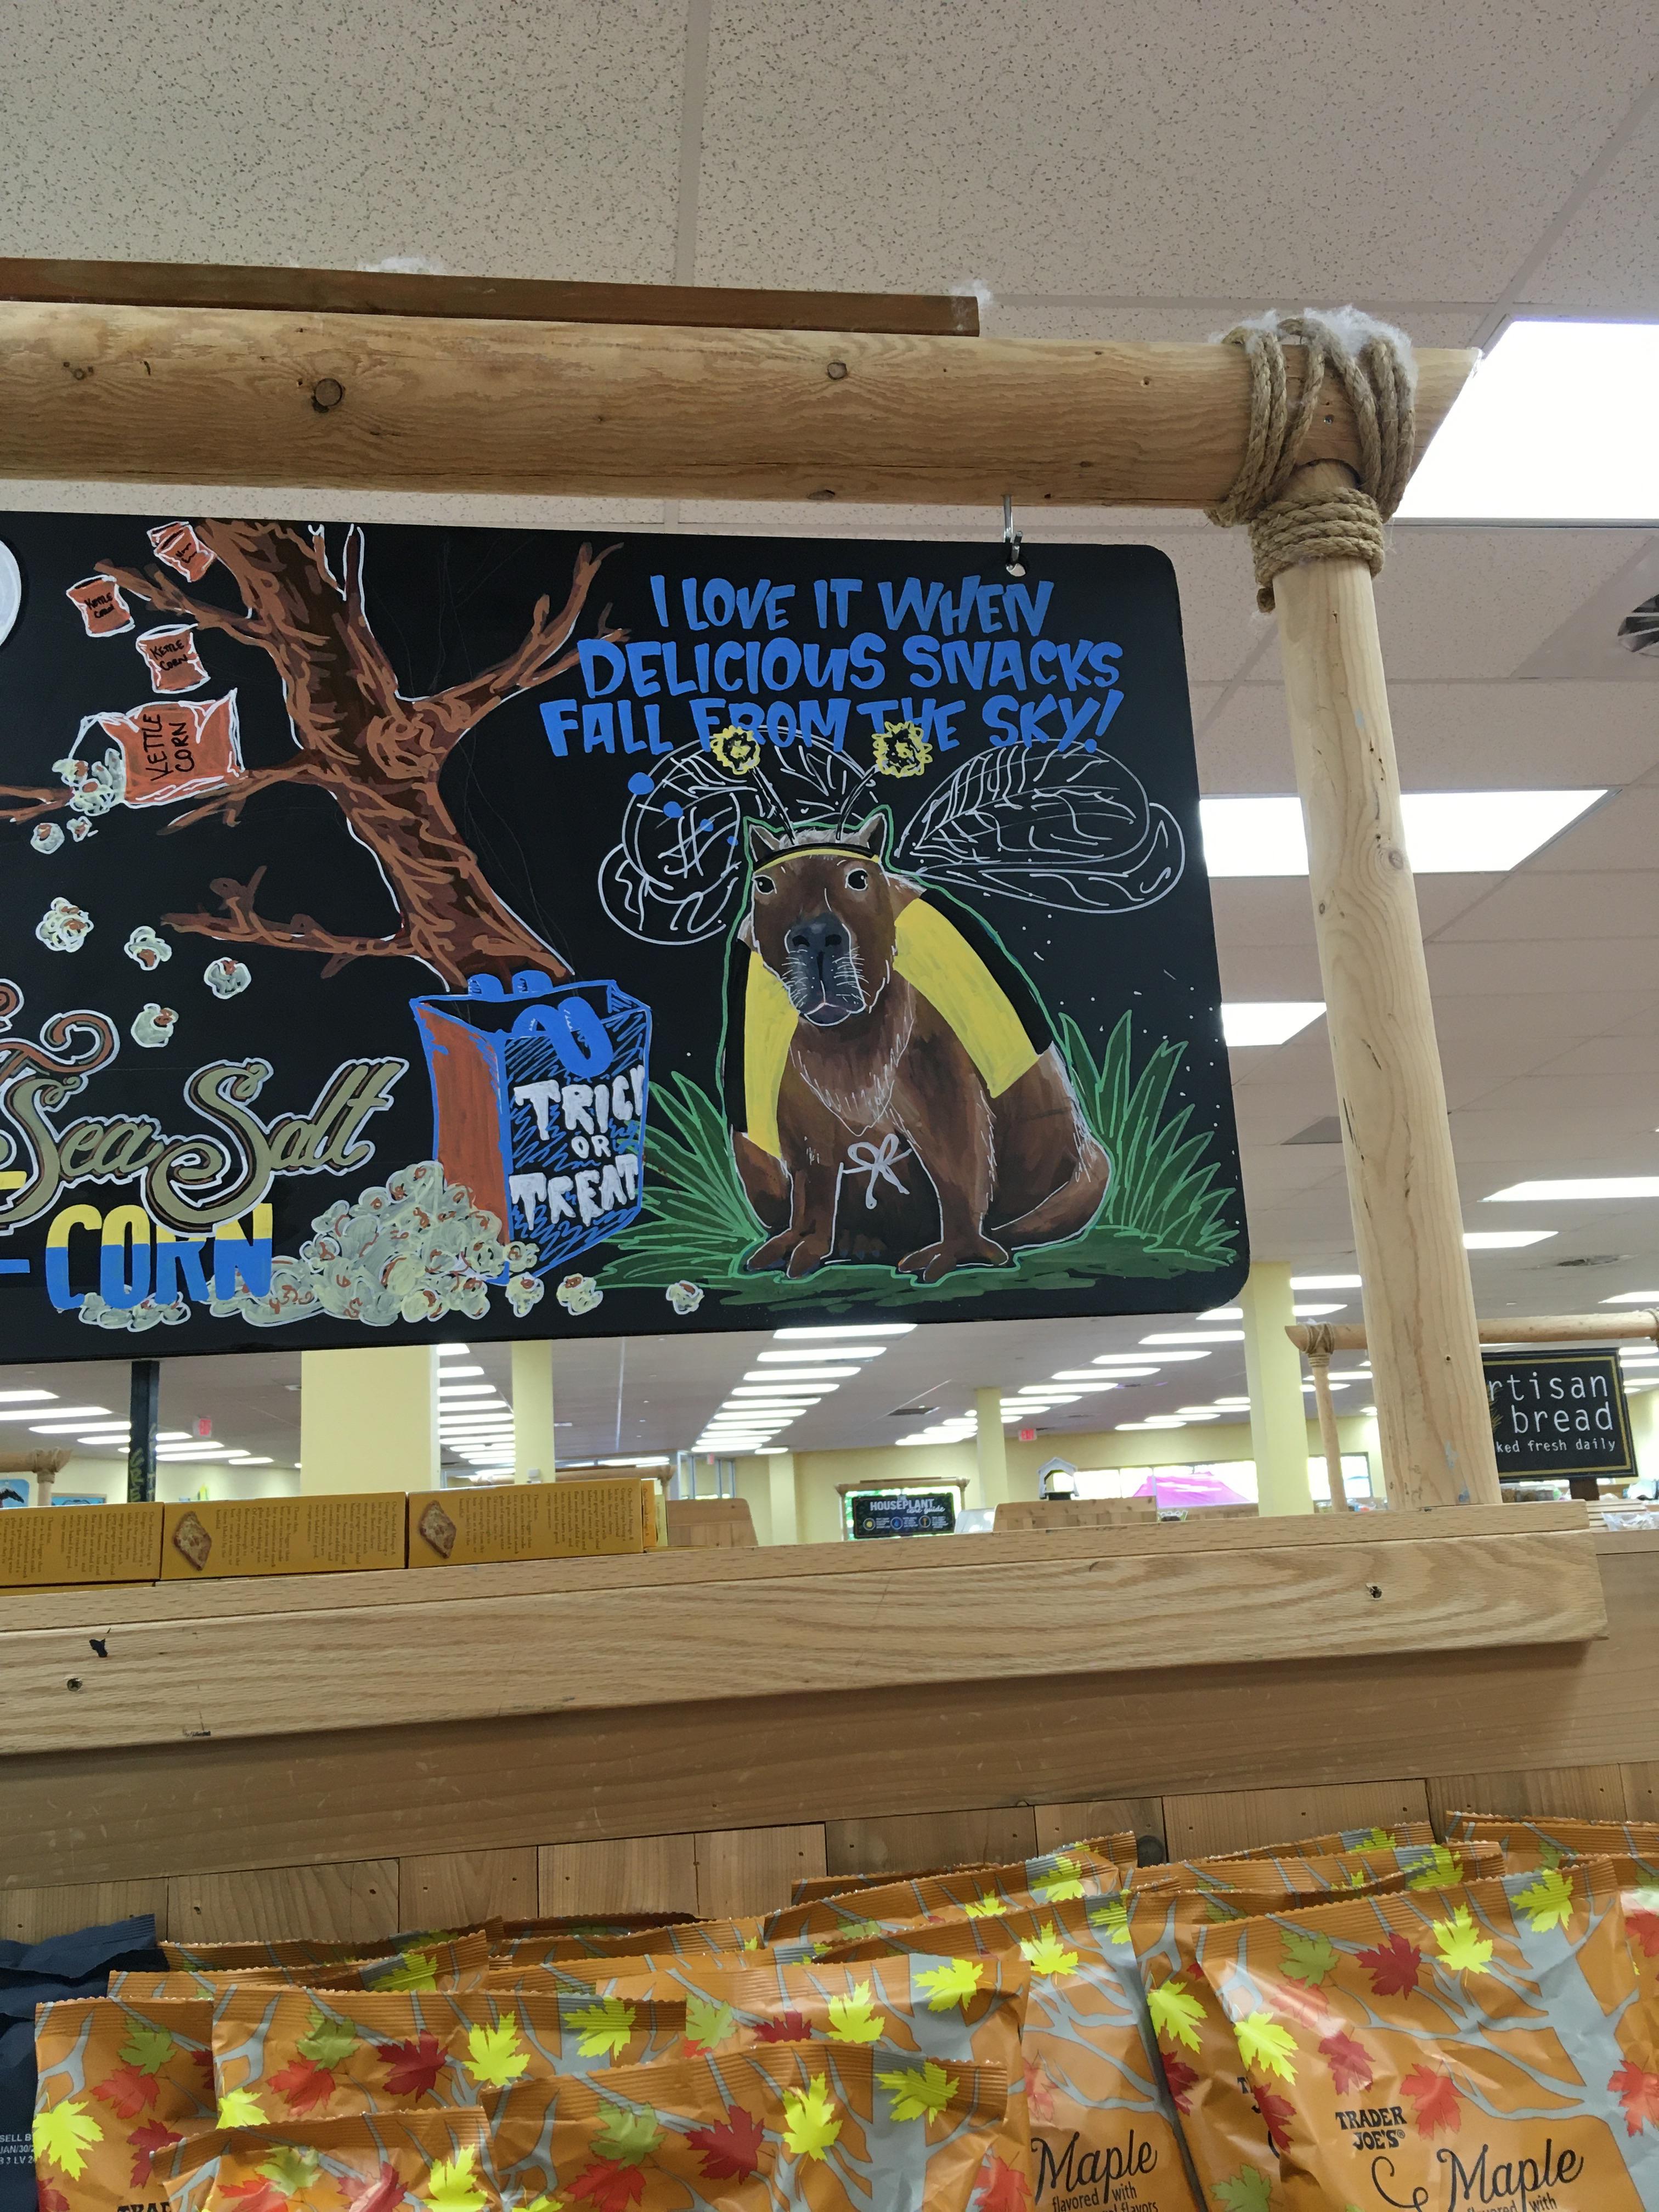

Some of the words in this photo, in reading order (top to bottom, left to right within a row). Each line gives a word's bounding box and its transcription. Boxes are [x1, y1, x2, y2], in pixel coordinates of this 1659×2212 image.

[651, 575, 669, 627] I
[682, 577, 795, 631] LOVE
[814, 579, 863, 629] IT
[878, 575, 1054, 636] WHEN
[150, 639, 184, 659] KETTLE
[159, 653, 188, 671] CORN
[577, 632, 886, 698] DELICIOUS
[902, 635, 1123, 691] SNACKS
[539, 699, 673, 757] FALL
[689, 698, 851, 753] FROM
[856, 697, 966, 752] THE
[982, 689, 1125, 754] SKY!
[142, 714, 174, 781] KETTLE
[168, 722, 195, 772] CORN
[0, 1075, 166, 1232] Sea
[145, 1059, 406, 1237] Salt
[571, 1135, 612, 1159] OR
[509, 1154, 640, 1231] TREAT
[1488, 1372, 1608, 1401] rtisan
[1511, 1401, 1613, 1434] bread
[1496, 1440, 1520, 1453] ked
[1527, 1439, 1567, 1452] fresh
[1576, 1437, 1616, 1452] daily
[870, 1499, 934, 1511] HOUSEPLANT
[1335, 2106, 1408, 2130] TRADER
[0, 2134, 22, 2142] SELL
[1031, 2129, 1158, 2206] Maple
[1437, 2138, 1584, 2212] Maple
[1052, 2188, 1099, 2212] flavored
[1111, 2181, 1138, 2202] with
[1528, 2192, 1558, 2212] with
